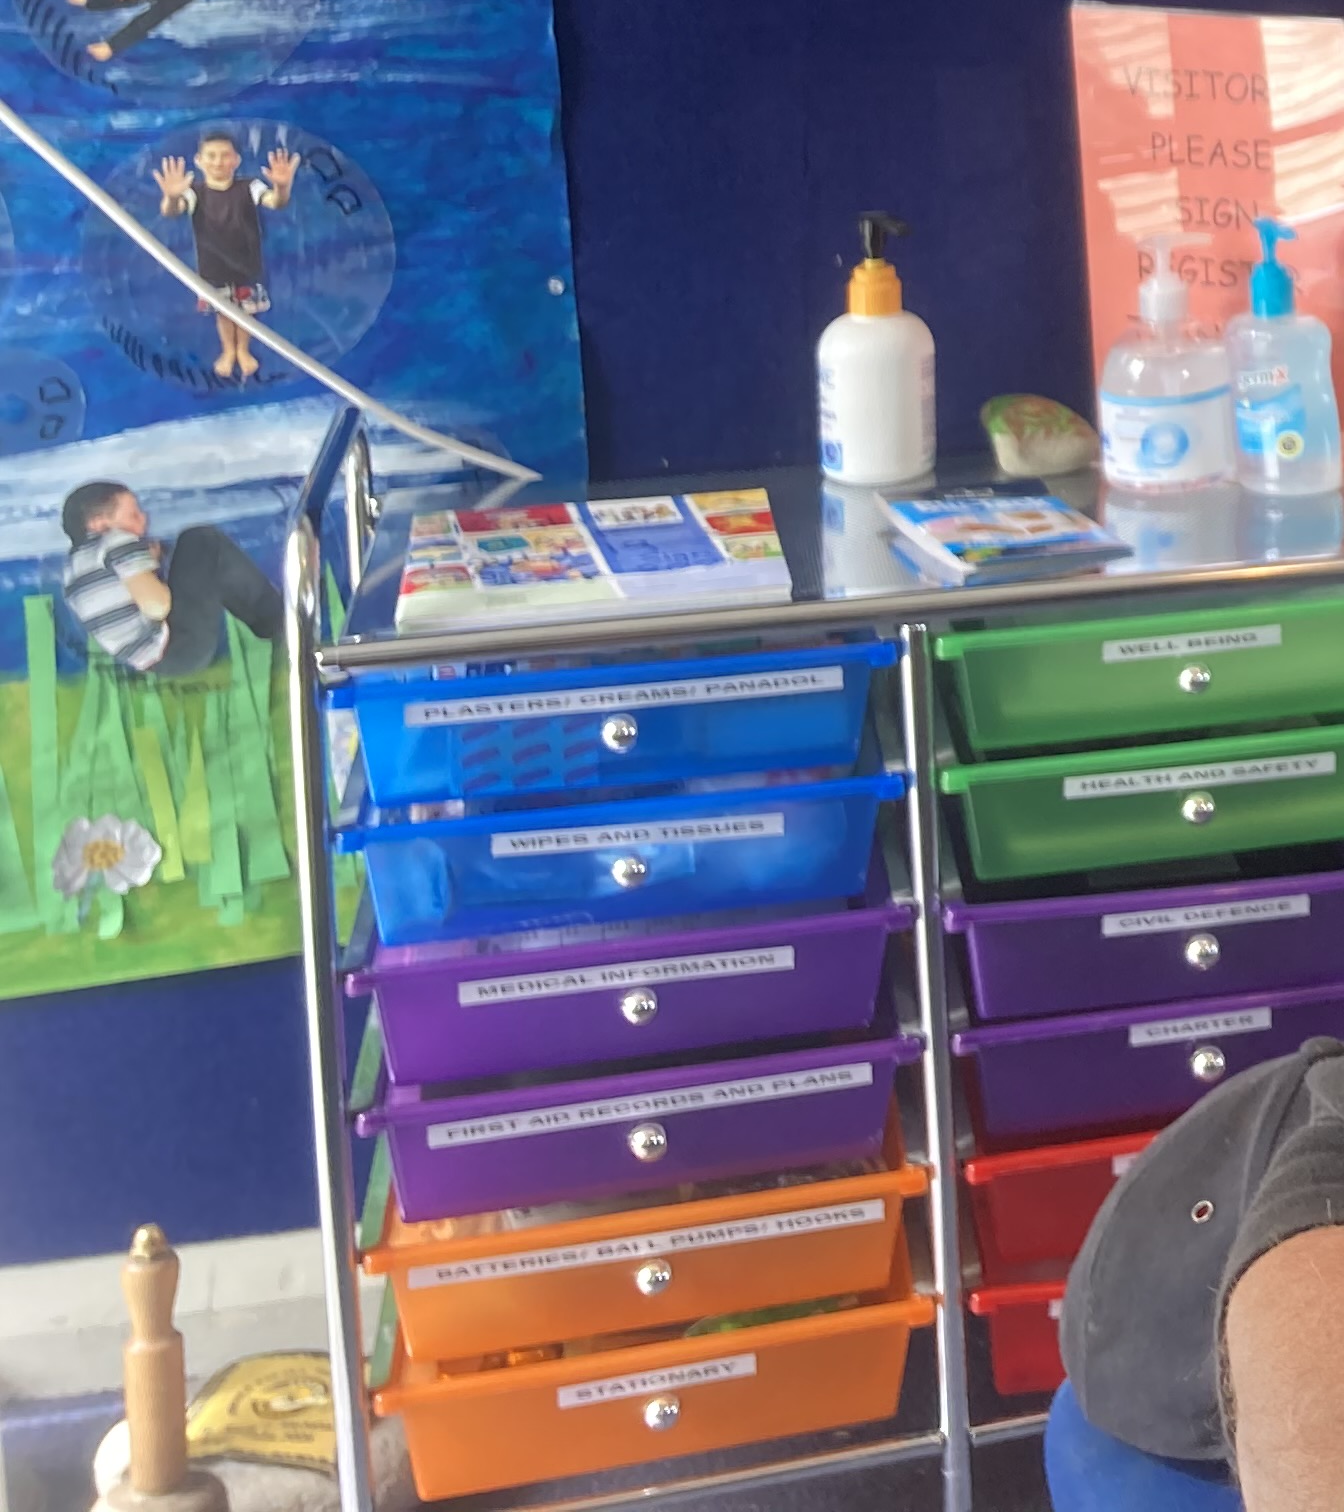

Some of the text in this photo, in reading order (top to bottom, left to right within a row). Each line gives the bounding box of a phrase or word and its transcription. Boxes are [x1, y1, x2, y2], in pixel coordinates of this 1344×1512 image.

[1150, 131, 1272, 171] PLEASE
[1176, 195, 1259, 230] SIGN
[1119, 632, 1257, 656] WELL BEING
[423, 695, 573, 721] PLASTERS/
[579, 684, 698, 706] CREAMS/
[1080, 758, 1319, 792] HEALTH AND SAFETY
[509, 818, 766, 851] WIPES AND TISSUES
[1119, 900, 1292, 929] CIVIL DEFENCE
[477, 952, 777, 998] MEDICAL INFORMATION
[1146, 1014, 1253, 1037] CHARTER
[445, 1069, 854, 1140] FIRST AID RECORDS AND PLANS
[435, 1207, 867, 1281] BATTERIES/ BALL PUMPS/ HOOKS
[575, 1360, 738, 1401] STATIONARY
